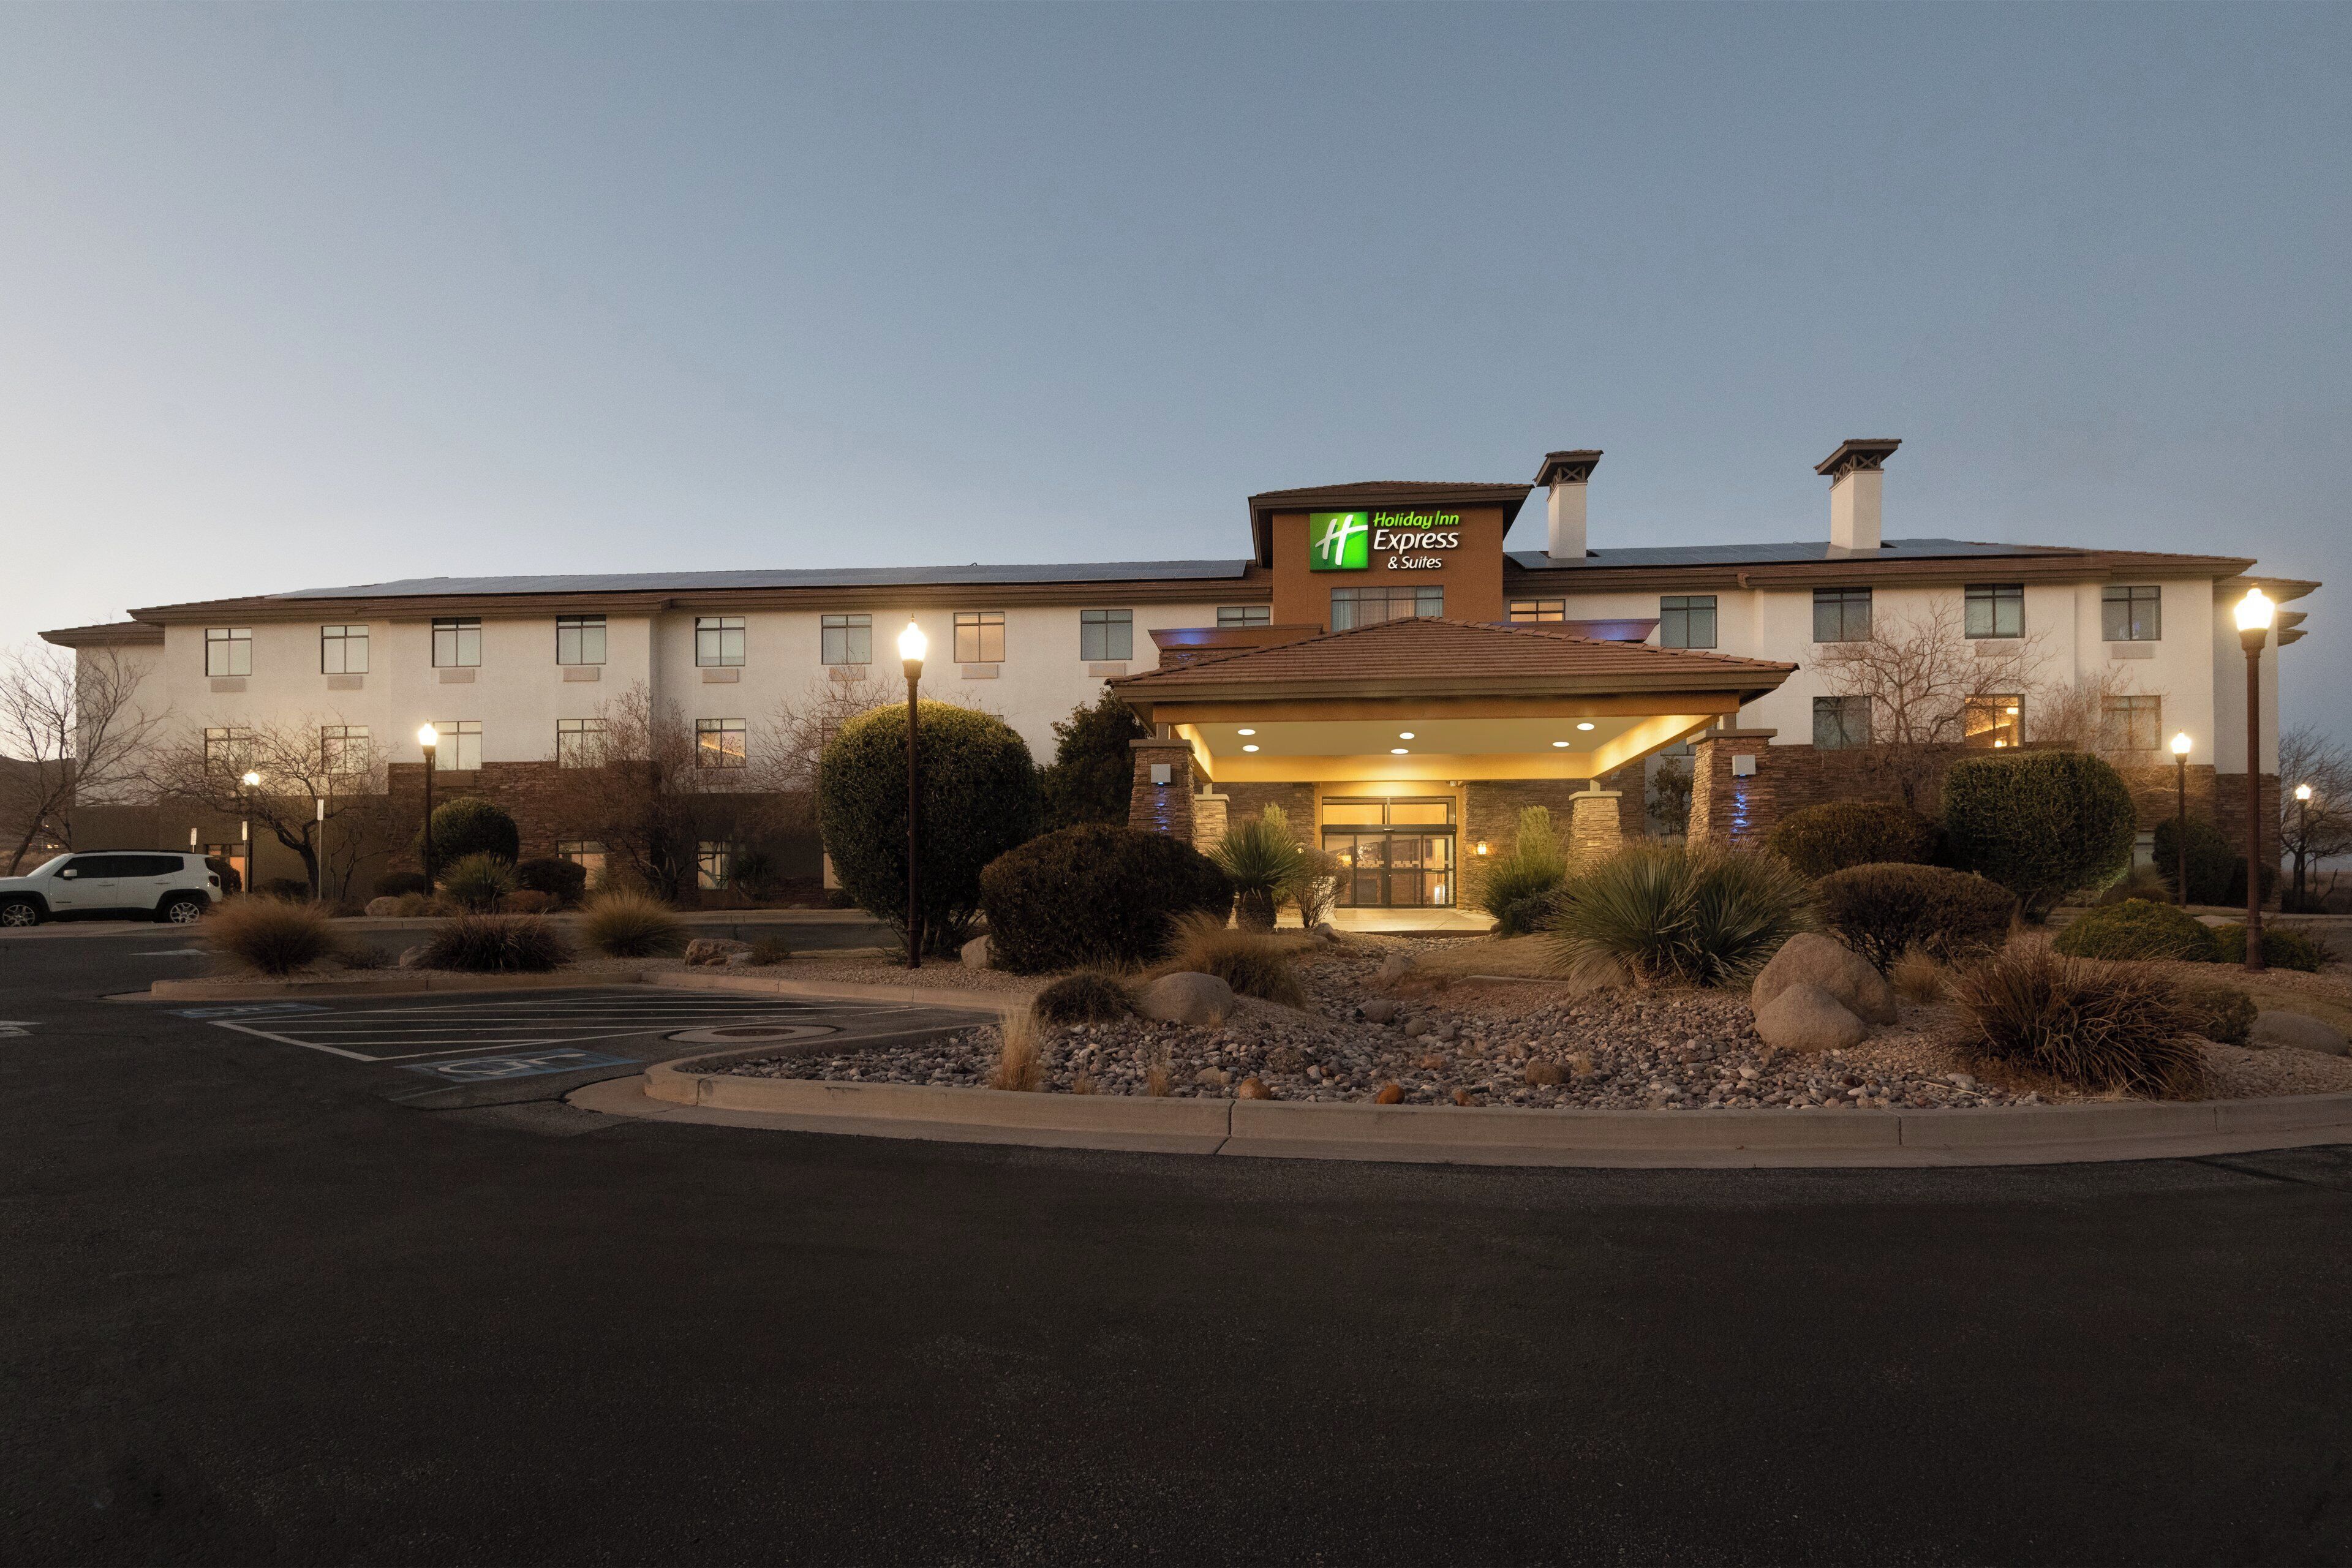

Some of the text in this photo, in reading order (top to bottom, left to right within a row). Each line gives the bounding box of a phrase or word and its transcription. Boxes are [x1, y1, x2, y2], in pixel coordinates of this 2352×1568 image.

[1373, 510, 1460, 530] Holiday Inn
[1373, 529, 1459, 555] Express
[1387, 556, 1442, 569] & Suites
